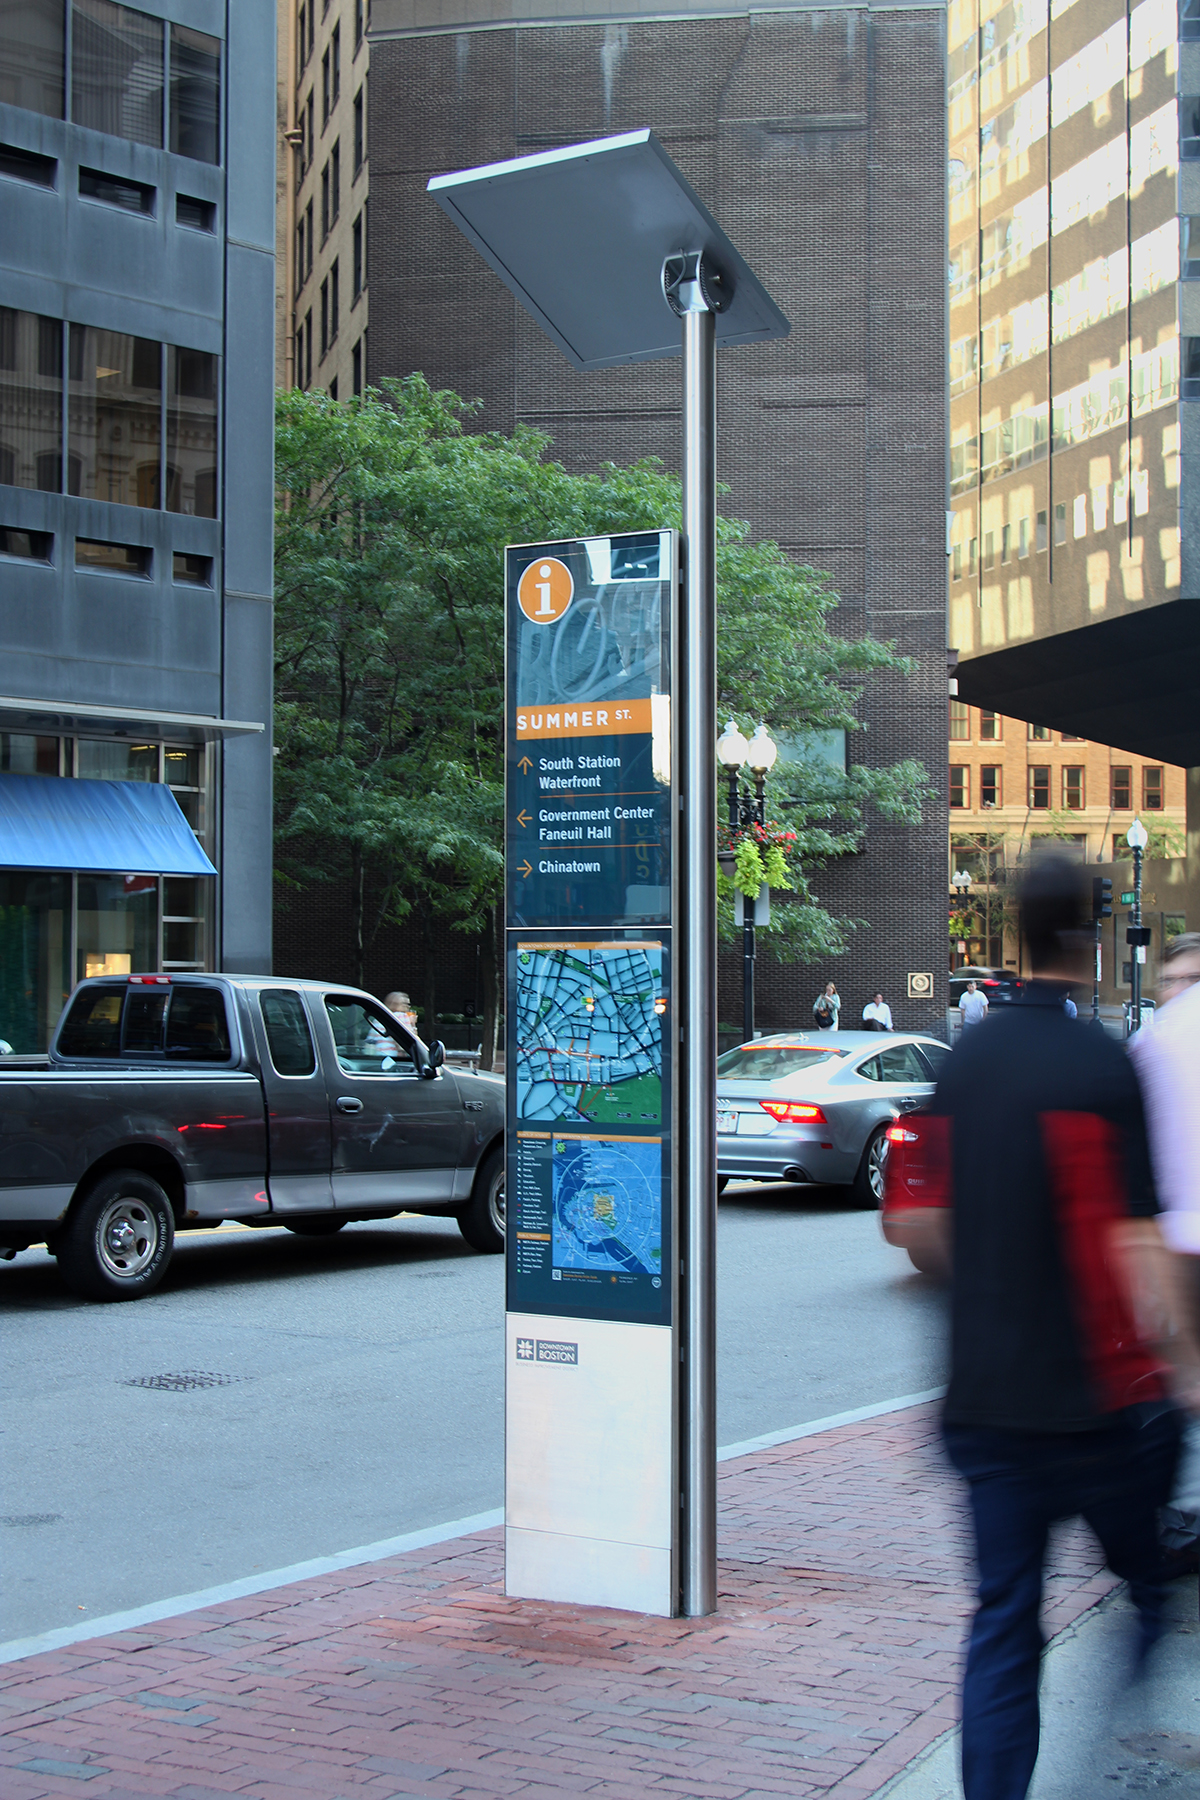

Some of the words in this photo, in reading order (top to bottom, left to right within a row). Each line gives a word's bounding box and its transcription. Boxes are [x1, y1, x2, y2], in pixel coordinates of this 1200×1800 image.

[516, 709, 609, 731] SUMMER
[615, 709, 632, 721] ST.
[539, 757, 574, 771] South
[577, 755, 621, 769] Station
[539, 774, 601, 790] Waterfront
[538, 807, 610, 822] Government
[613, 806, 654, 819] Center
[539, 827, 583, 841] Faneuil
[587, 826, 612, 839] Hall
[538, 860, 600, 873] Chinatown
[539, 1342, 575, 1352] DOWNTOWN
[539, 1350, 575, 1362] BOSTON
